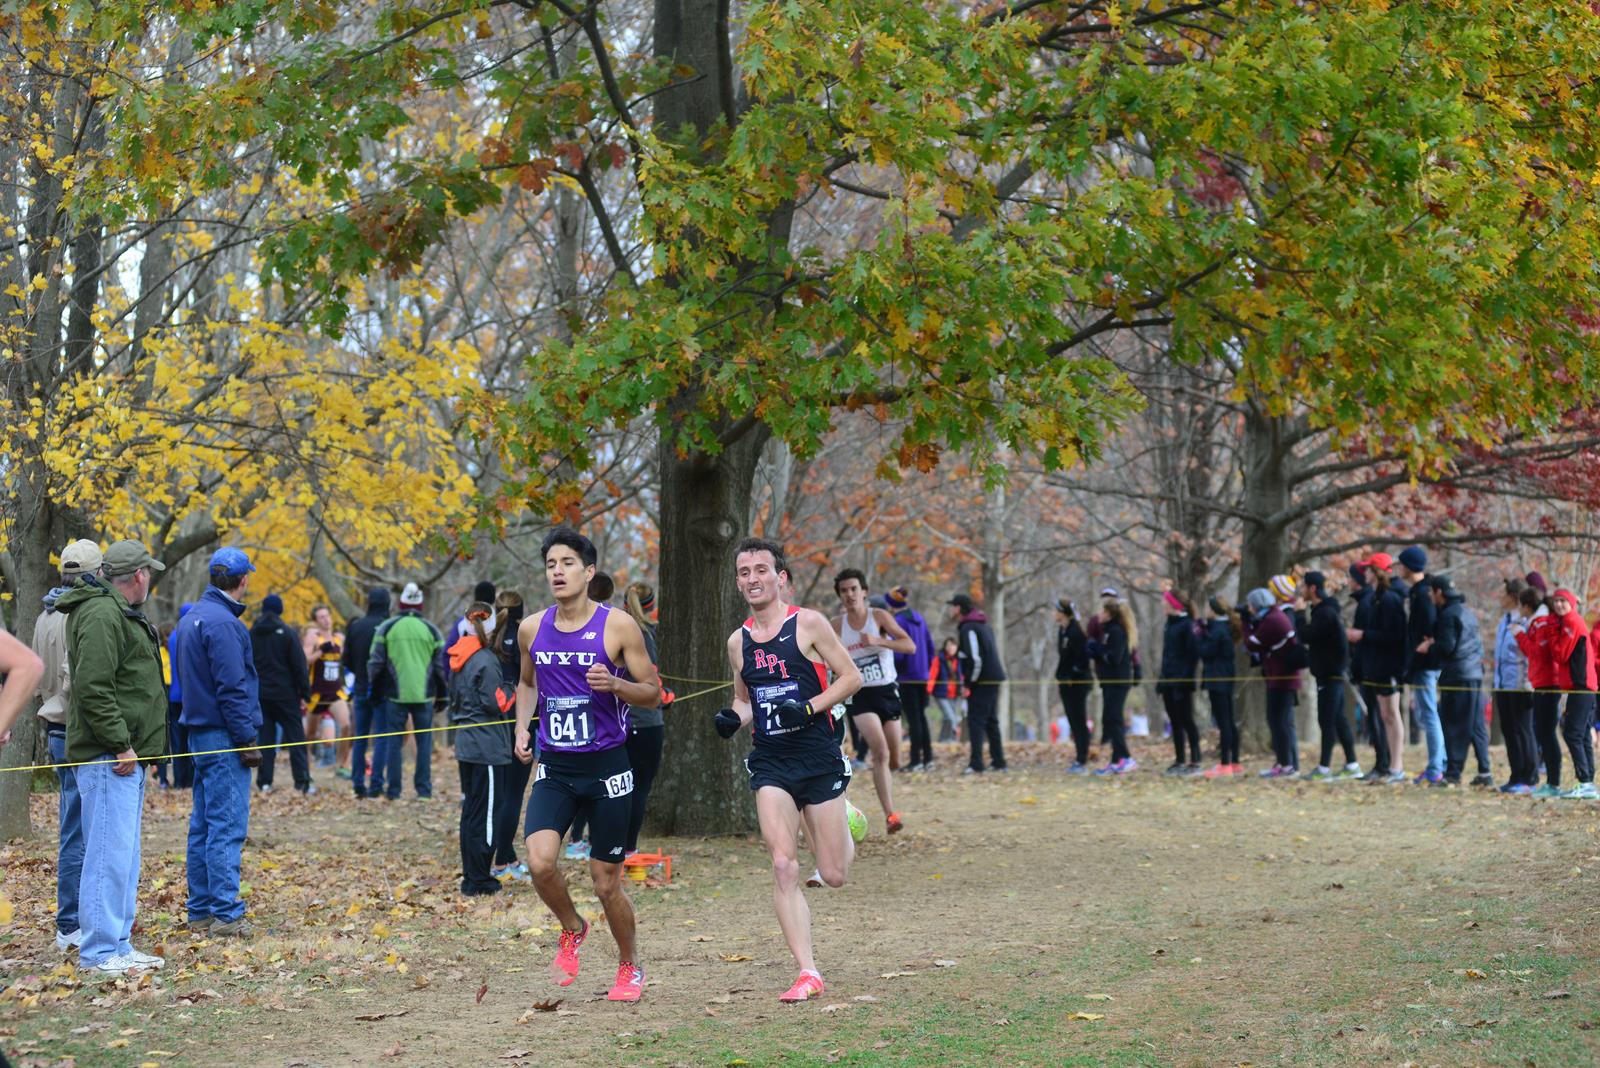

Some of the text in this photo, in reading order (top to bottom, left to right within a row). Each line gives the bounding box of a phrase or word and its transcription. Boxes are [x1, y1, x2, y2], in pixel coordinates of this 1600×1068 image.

[535, 652, 596, 666] NYU
[754, 649, 790, 679] RPI
[859, 663, 883, 682] 66
[550, 712, 589, 741] 641
[609, 774, 632, 796] 641
